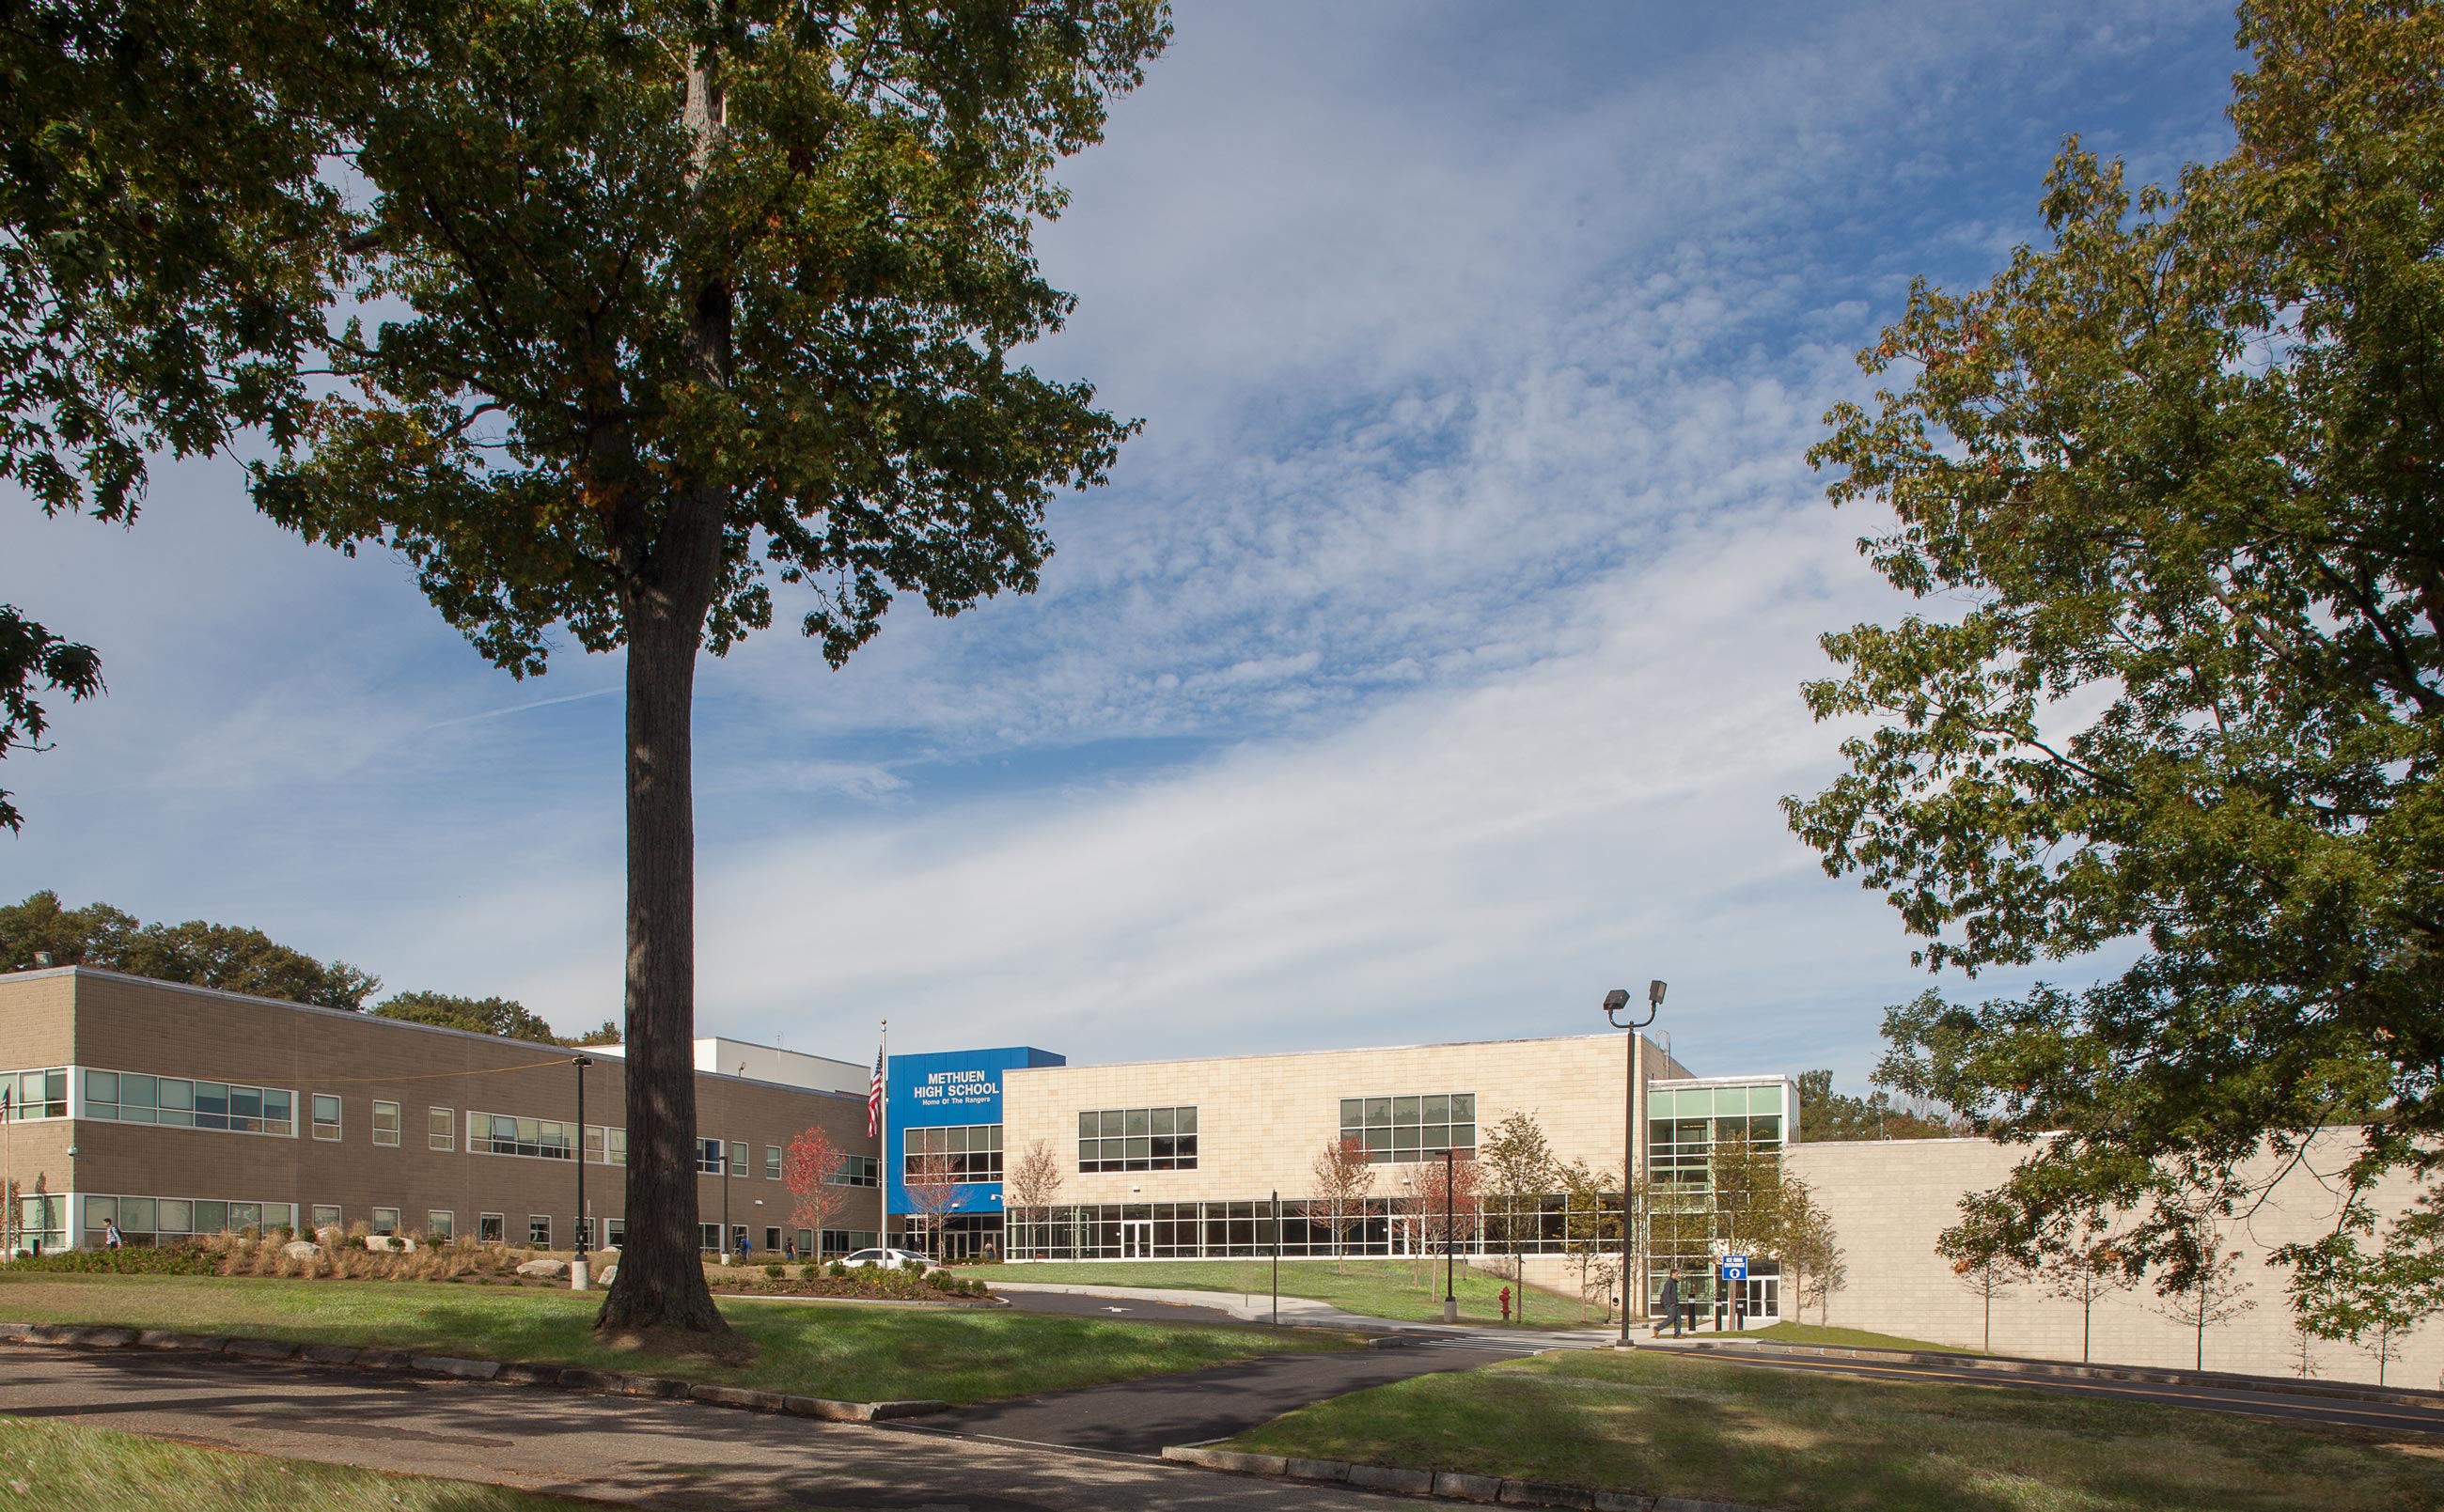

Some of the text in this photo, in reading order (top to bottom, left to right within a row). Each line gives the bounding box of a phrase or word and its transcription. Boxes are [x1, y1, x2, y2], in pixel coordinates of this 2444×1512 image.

[928, 1070, 985, 1084] METHUEN
[914, 1083, 999, 1098] HIGH SCHOOL
